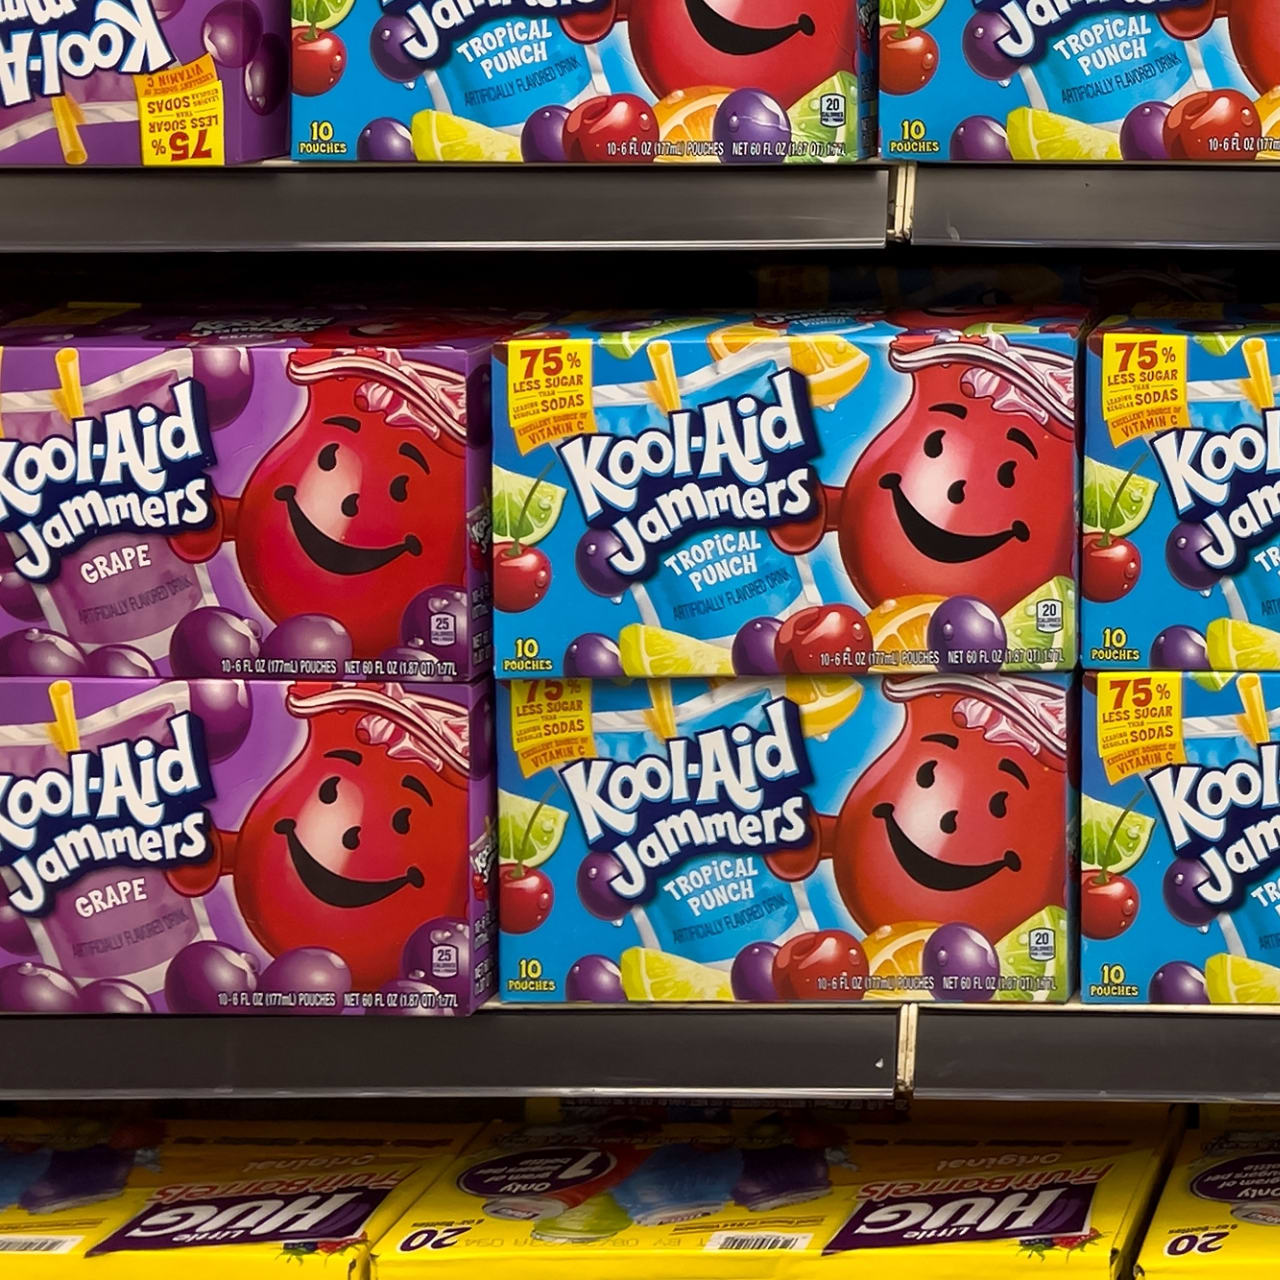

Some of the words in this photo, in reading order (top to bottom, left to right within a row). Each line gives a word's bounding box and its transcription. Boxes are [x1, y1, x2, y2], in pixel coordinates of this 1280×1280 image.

[560, 371, 804, 517] Kool-Aid
[15, 479, 208, 579] Jammers
[610, 468, 810, 573] Jammers
[81, 545, 151, 583] GRAPE
[9, 813, 206, 911] Jammers
[75, 878, 147, 917] GRAPE
[125, 1191, 357, 1238] HUG
[854, 1188, 1068, 1235] HUG
[398, 1226, 472, 1253] 20
[1165, 1232, 1230, 1257] 20
